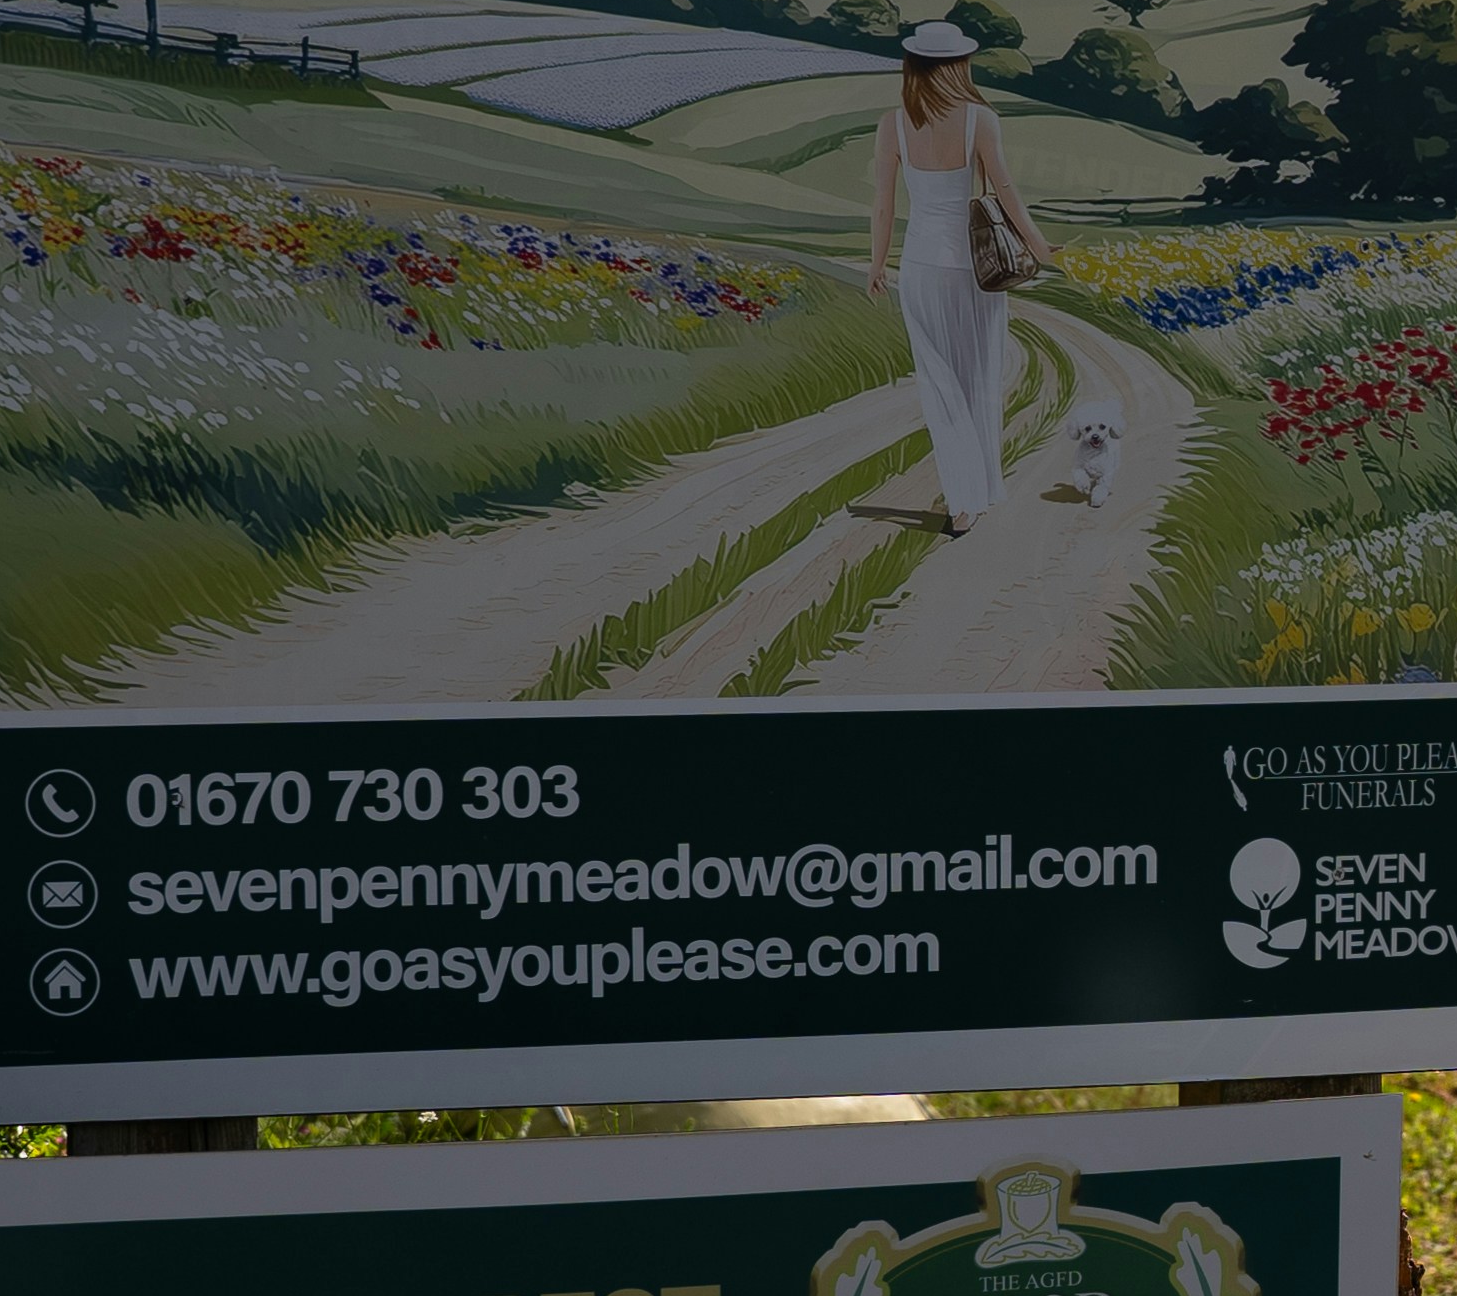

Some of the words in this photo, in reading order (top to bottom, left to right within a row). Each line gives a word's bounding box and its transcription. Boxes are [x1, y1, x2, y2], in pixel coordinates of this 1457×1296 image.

[1242, 746, 1288, 780] GO
[1294, 745, 1326, 774] AS
[1332, 744, 1389, 774] YOU
[126, 770, 312, 828] 01670
[328, 767, 444, 822] 730
[461, 764, 580, 820] 303
[1300, 777, 1436, 811] FUNERALS
[127, 833, 1158, 924] sevenpennymeadow@gmail.com
[1315, 852, 1426, 887] SEVEN
[1315, 888, 1437, 924] PENNY
[128, 926, 940, 1008] www.goasyouplease.com
[978, 1274, 1020, 1293] THE
[1024, 1270, 1083, 1290] AGFD
